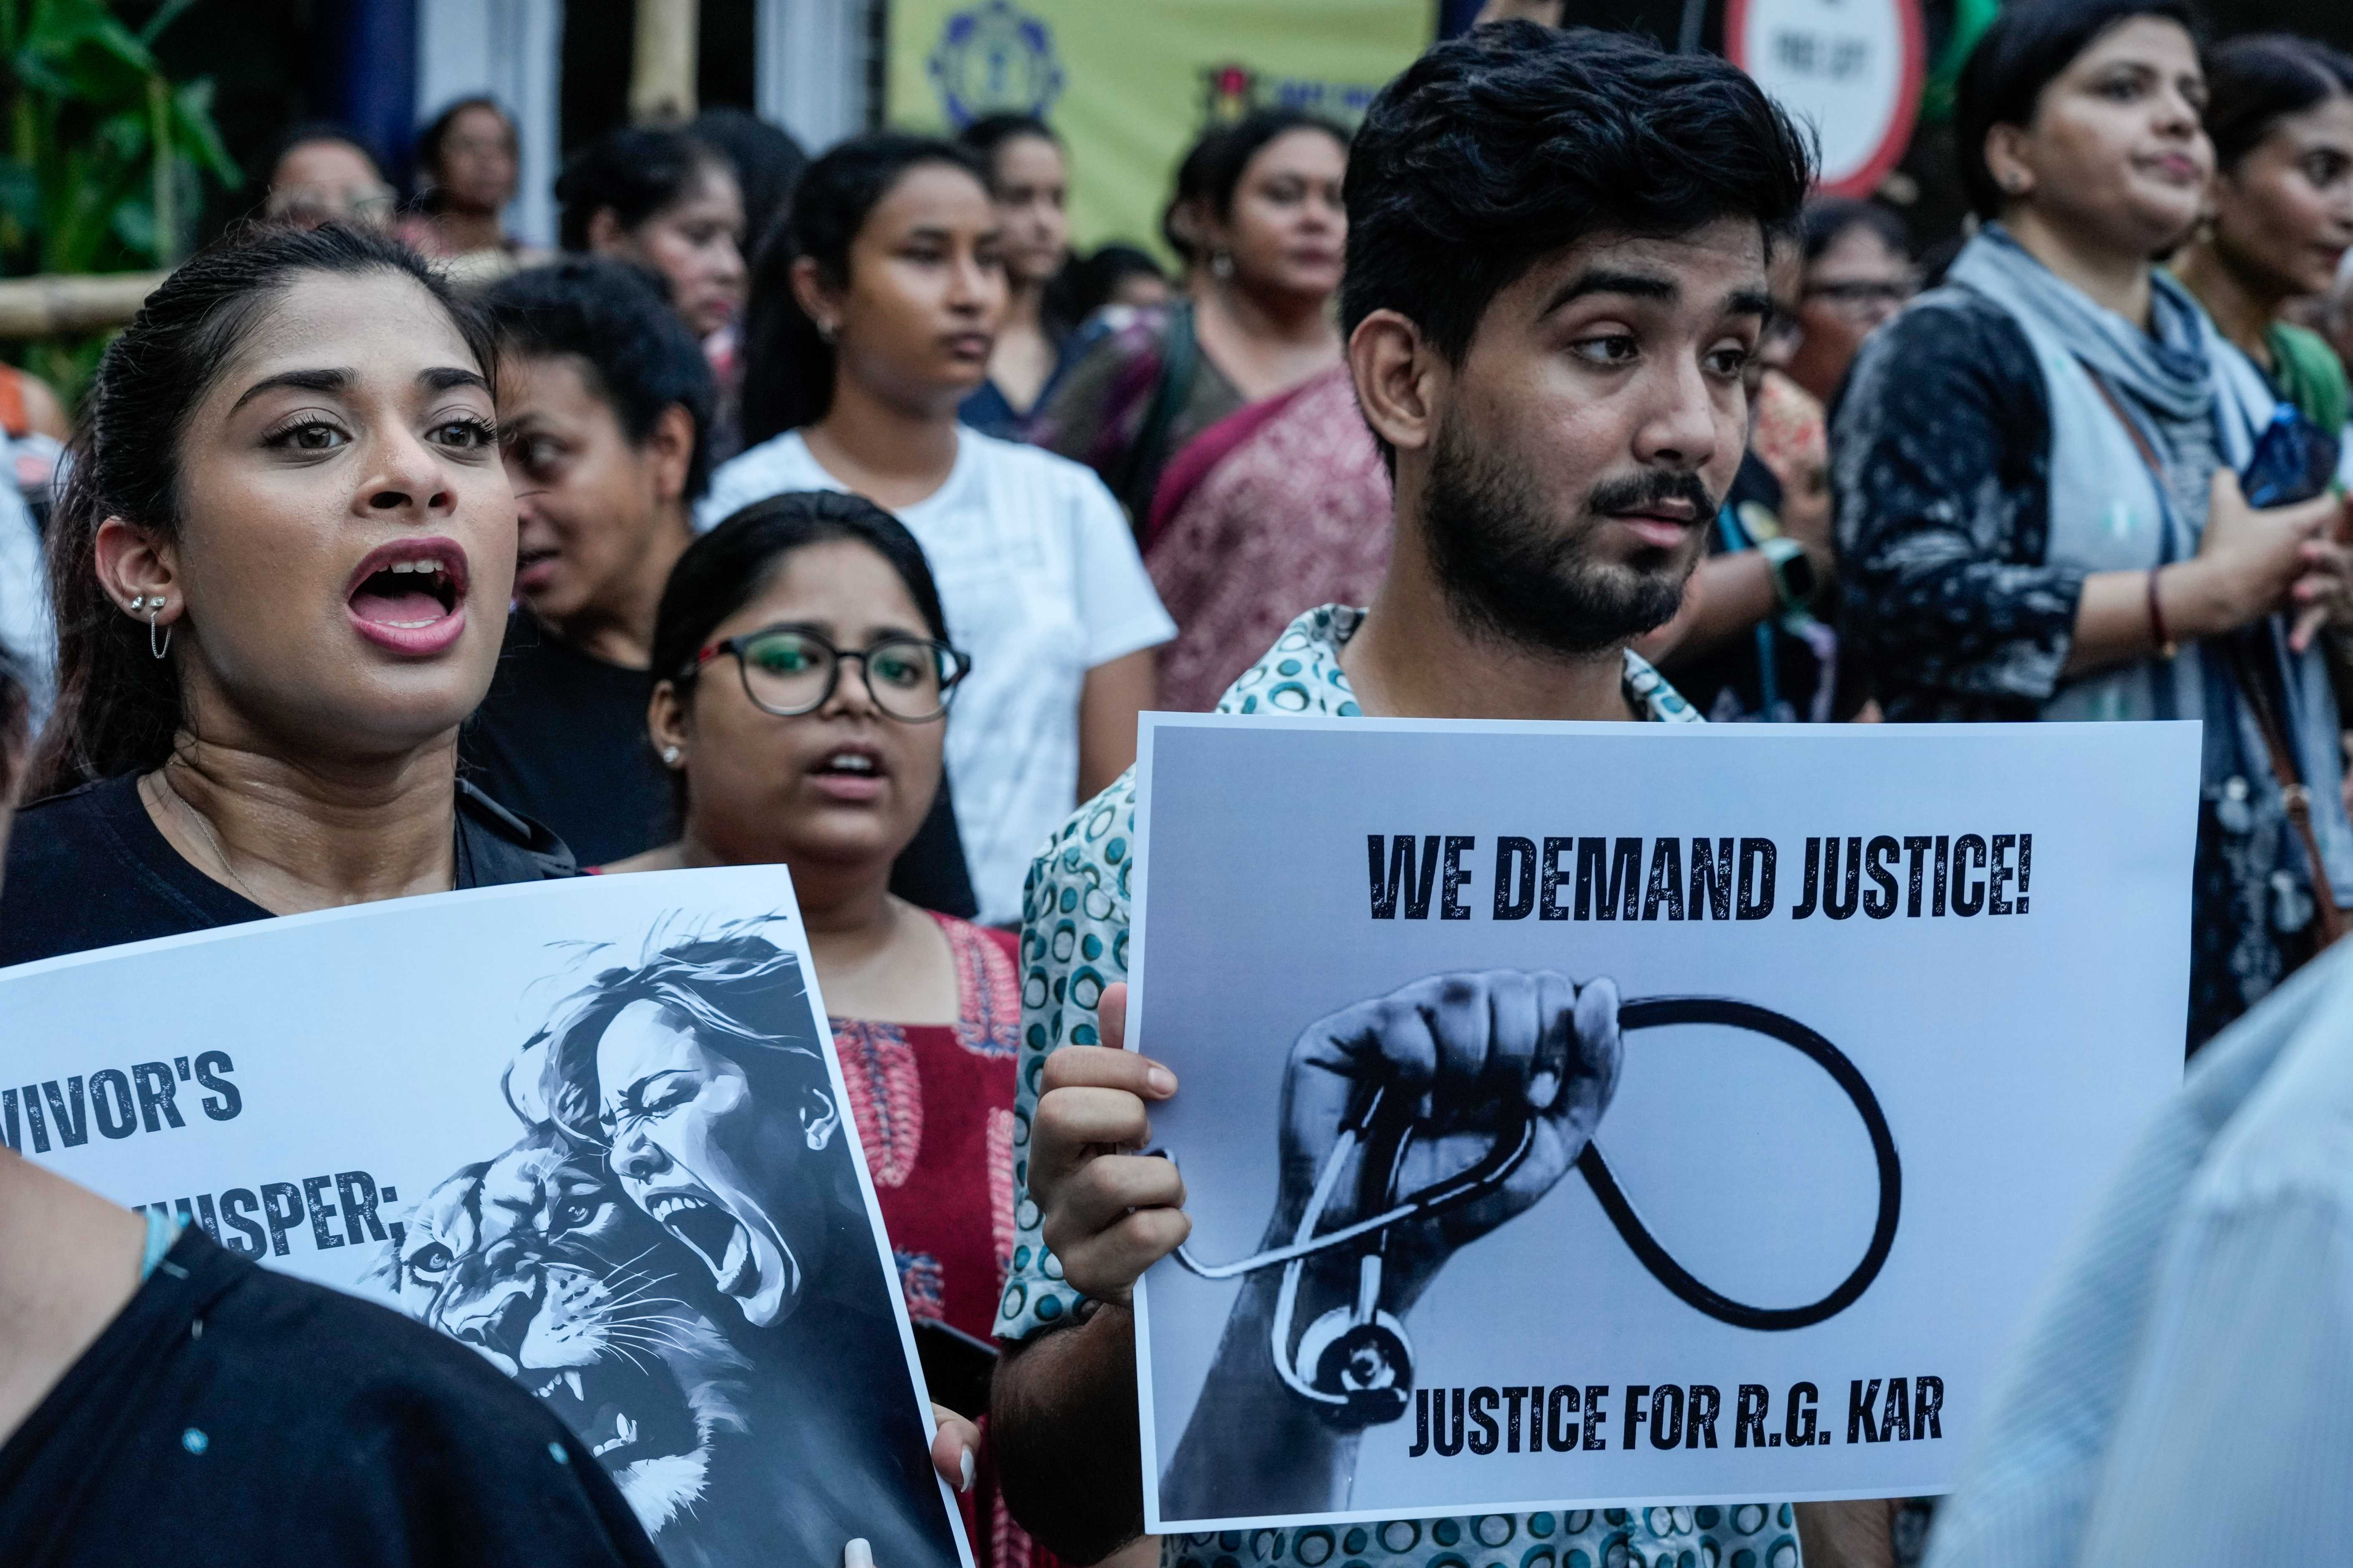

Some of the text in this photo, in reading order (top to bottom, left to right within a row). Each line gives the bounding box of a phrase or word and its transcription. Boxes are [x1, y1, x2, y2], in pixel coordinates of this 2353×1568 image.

[1368, 834, 2032, 921] WE DEMAND JUSTICE!
[131, 1171, 406, 1262] ISPER;
[1409, 1376, 1944, 1457] JUSTICE FOR R.G. KAR
